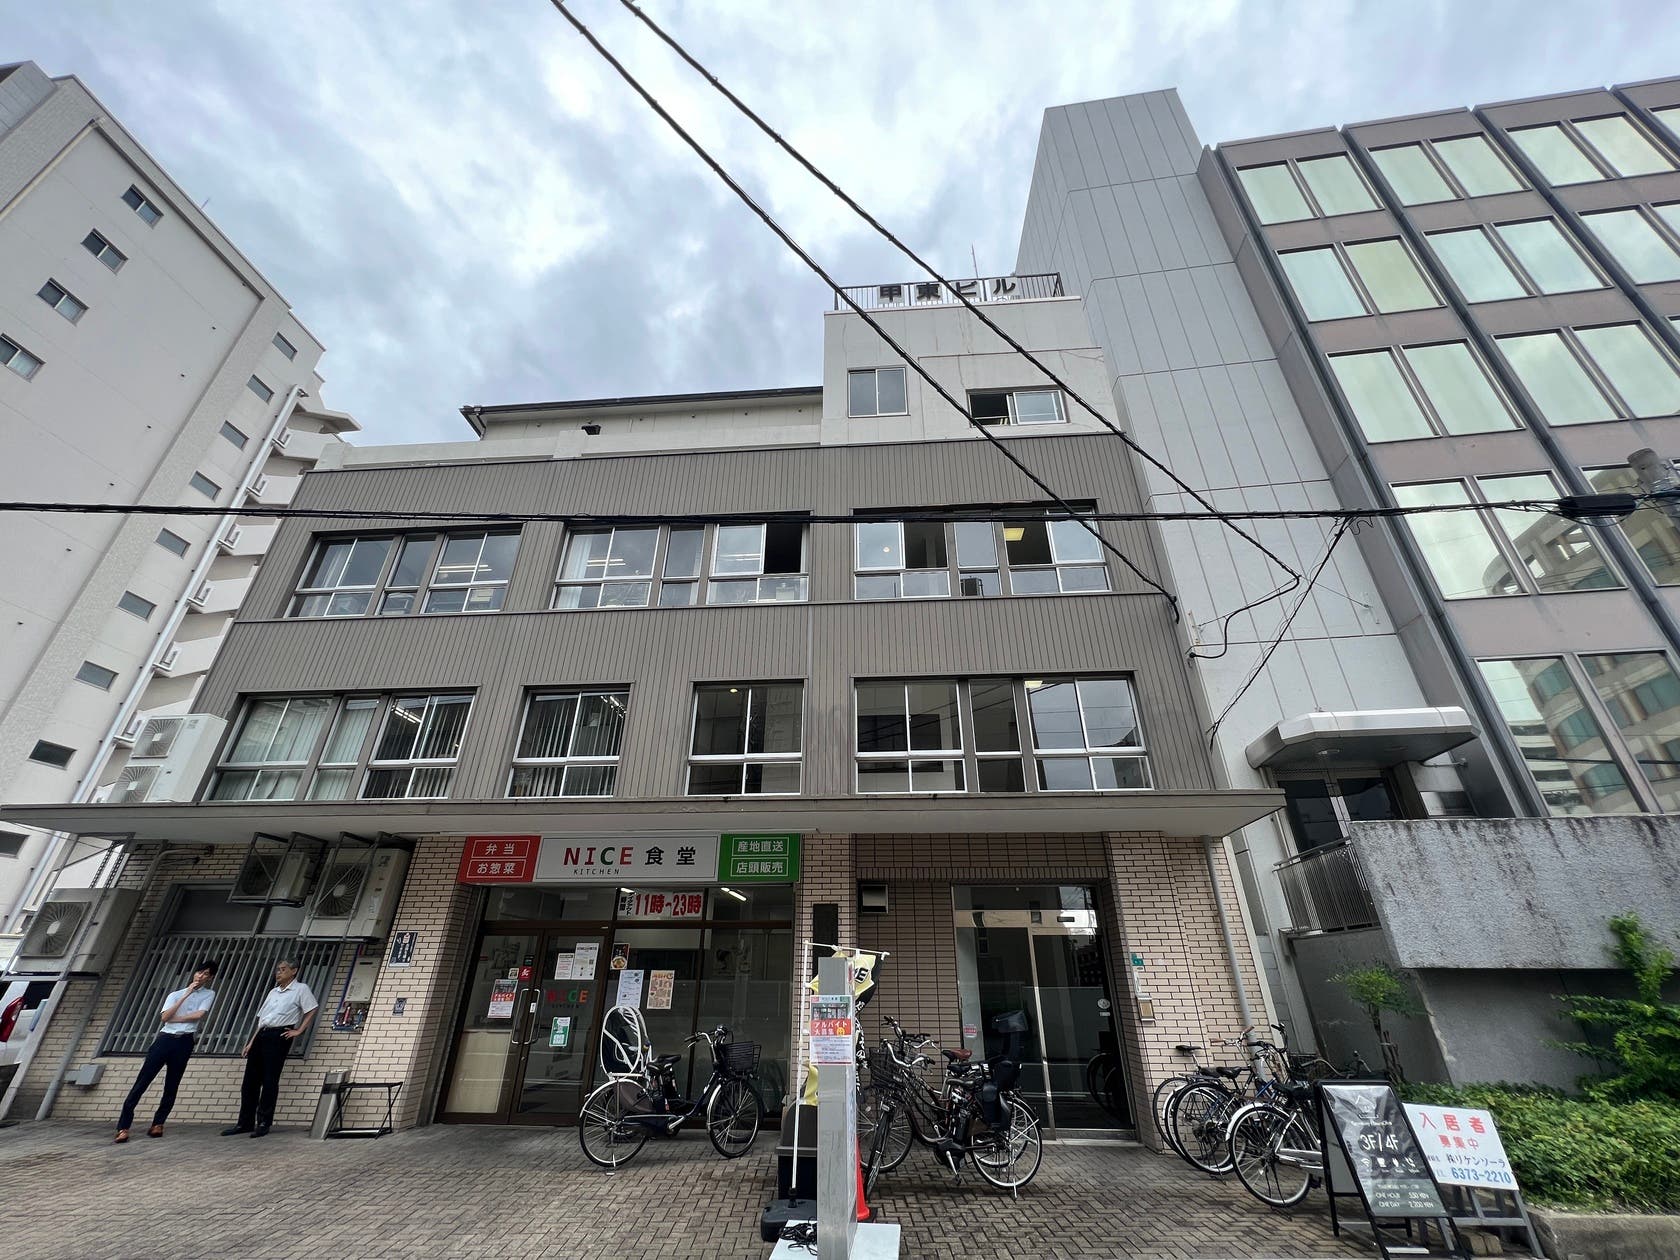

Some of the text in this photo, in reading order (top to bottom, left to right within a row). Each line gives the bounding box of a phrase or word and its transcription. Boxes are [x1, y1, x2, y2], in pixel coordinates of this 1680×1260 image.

[879, 278, 1017, 303] 甲東ビル
[485, 843, 516, 856] 弁当
[737, 840, 785, 853] 産地直送
[563, 846, 696, 866] NICE 食堂
[476, 862, 516, 875] お惣菜
[573, 868, 621, 876] KITCHEN
[736, 861, 784, 874] 店頭販売
[1419, 1112, 1486, 1134] 入居者
[1451, 1167, 1513, 1184] 6373-2210
